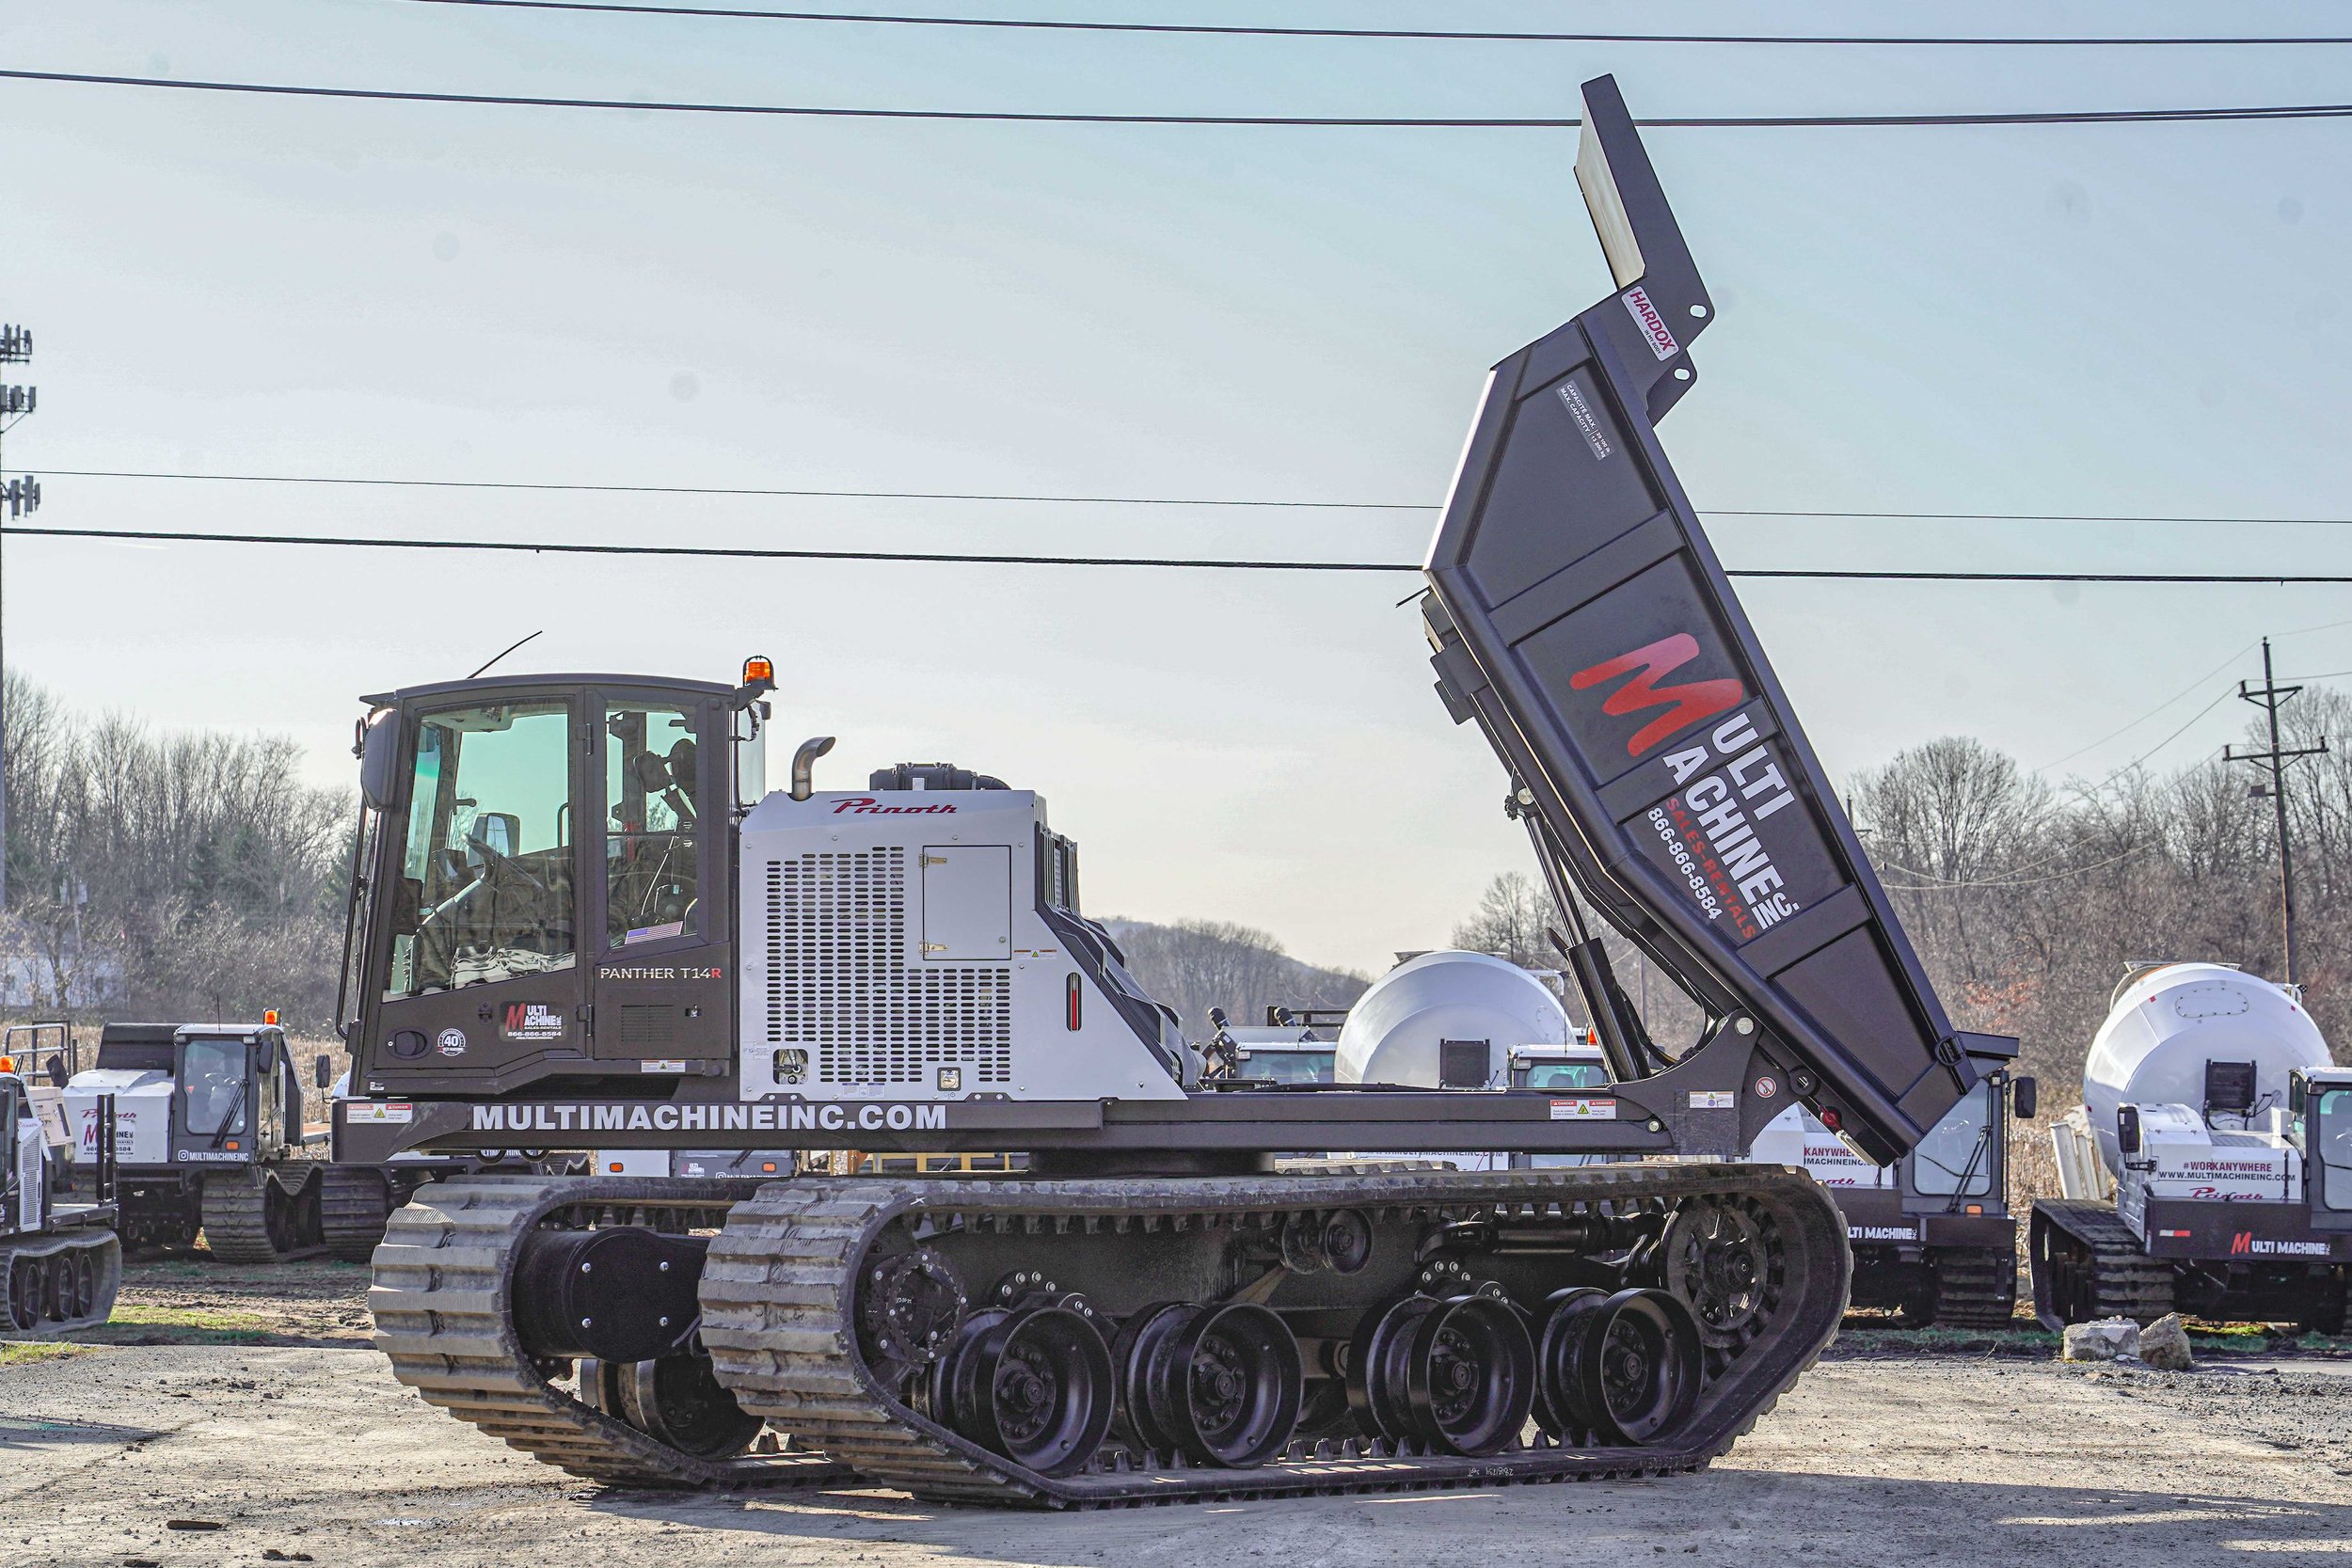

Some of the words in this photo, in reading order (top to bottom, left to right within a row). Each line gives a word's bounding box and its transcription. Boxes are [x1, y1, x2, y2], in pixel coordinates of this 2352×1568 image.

[1629, 292, 1675, 352] HARDOX
[1652, 342, 1661, 355] BODY
[1560, 388, 1572, 404] MAX.
[1569, 403, 1591, 433] CAPACITY
[1566, 384, 1588, 414] CAPACITÉ
[1584, 413, 1597, 429] MAX.
[830, 798, 958, 814] Prinoth
[1647, 807, 1724, 920] 866-866-8584
[1666, 797, 1756, 939] SALES-RENTALS
[1751, 892, 1801, 930] INC.
[600, 967, 675, 979] PANTHER
[679, 967, 723, 979] T14R
[444, 1036, 459, 1047] 40
[472, 1104, 947, 1131] MULTIMACHINEINC.COM
[189, 1151, 249, 1163] MULTIMACHINEINC
[2183, 1161, 2273, 1173] #WORKANYWHERE
[1865, 1227, 1913, 1241] MACHINE
[2277, 1241, 2327, 1256] MACHINE
